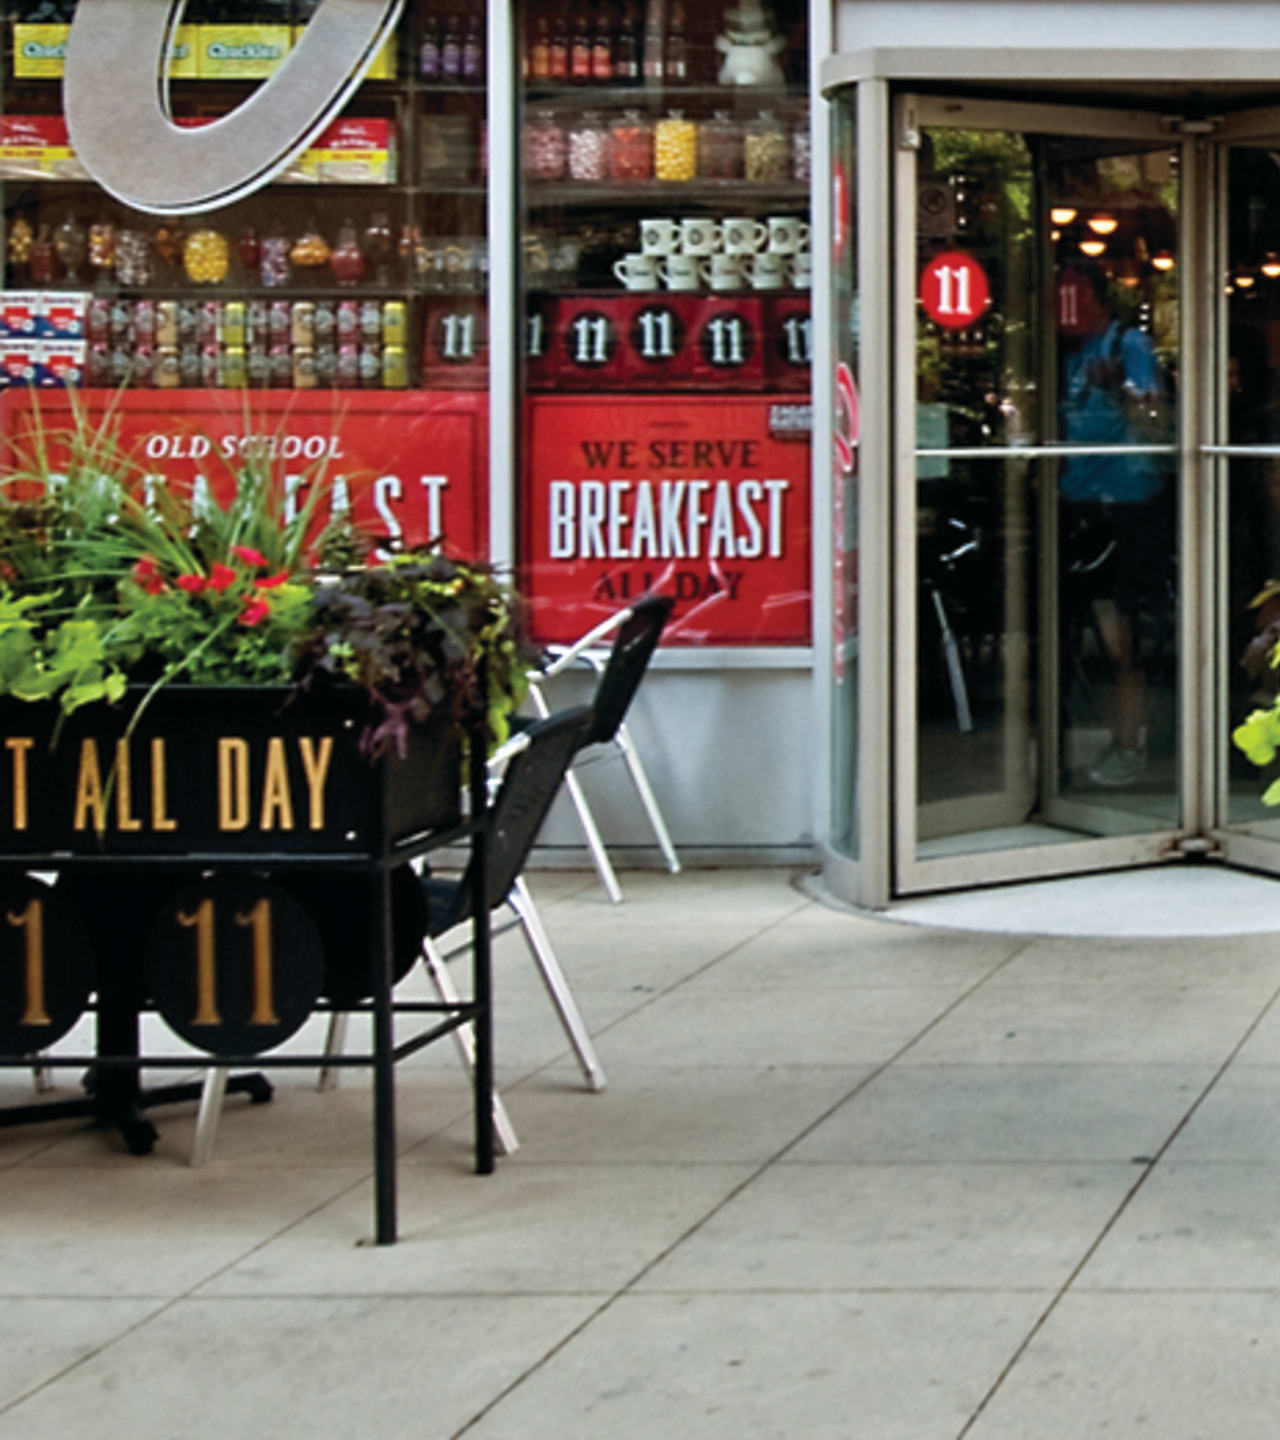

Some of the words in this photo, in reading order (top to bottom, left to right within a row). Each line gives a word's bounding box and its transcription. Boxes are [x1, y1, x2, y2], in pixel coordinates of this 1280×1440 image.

[933, 264, 973, 315] 11
[573, 317, 608, 362] 11
[638, 310, 674, 356] 11
[707, 318, 744, 363] 11
[145, 434, 211, 460] OLD
[220, 434, 345, 460] SCHOOL
[580, 440, 638, 469] WE
[648, 439, 760, 470] SERVE
[549, 479, 789, 559] BREAKFAST
[675, 571, 744, 602] DAY
[73, 737, 178, 832] ALL
[217, 737, 334, 832] DAY
[175, 898, 282, 1027] 11
